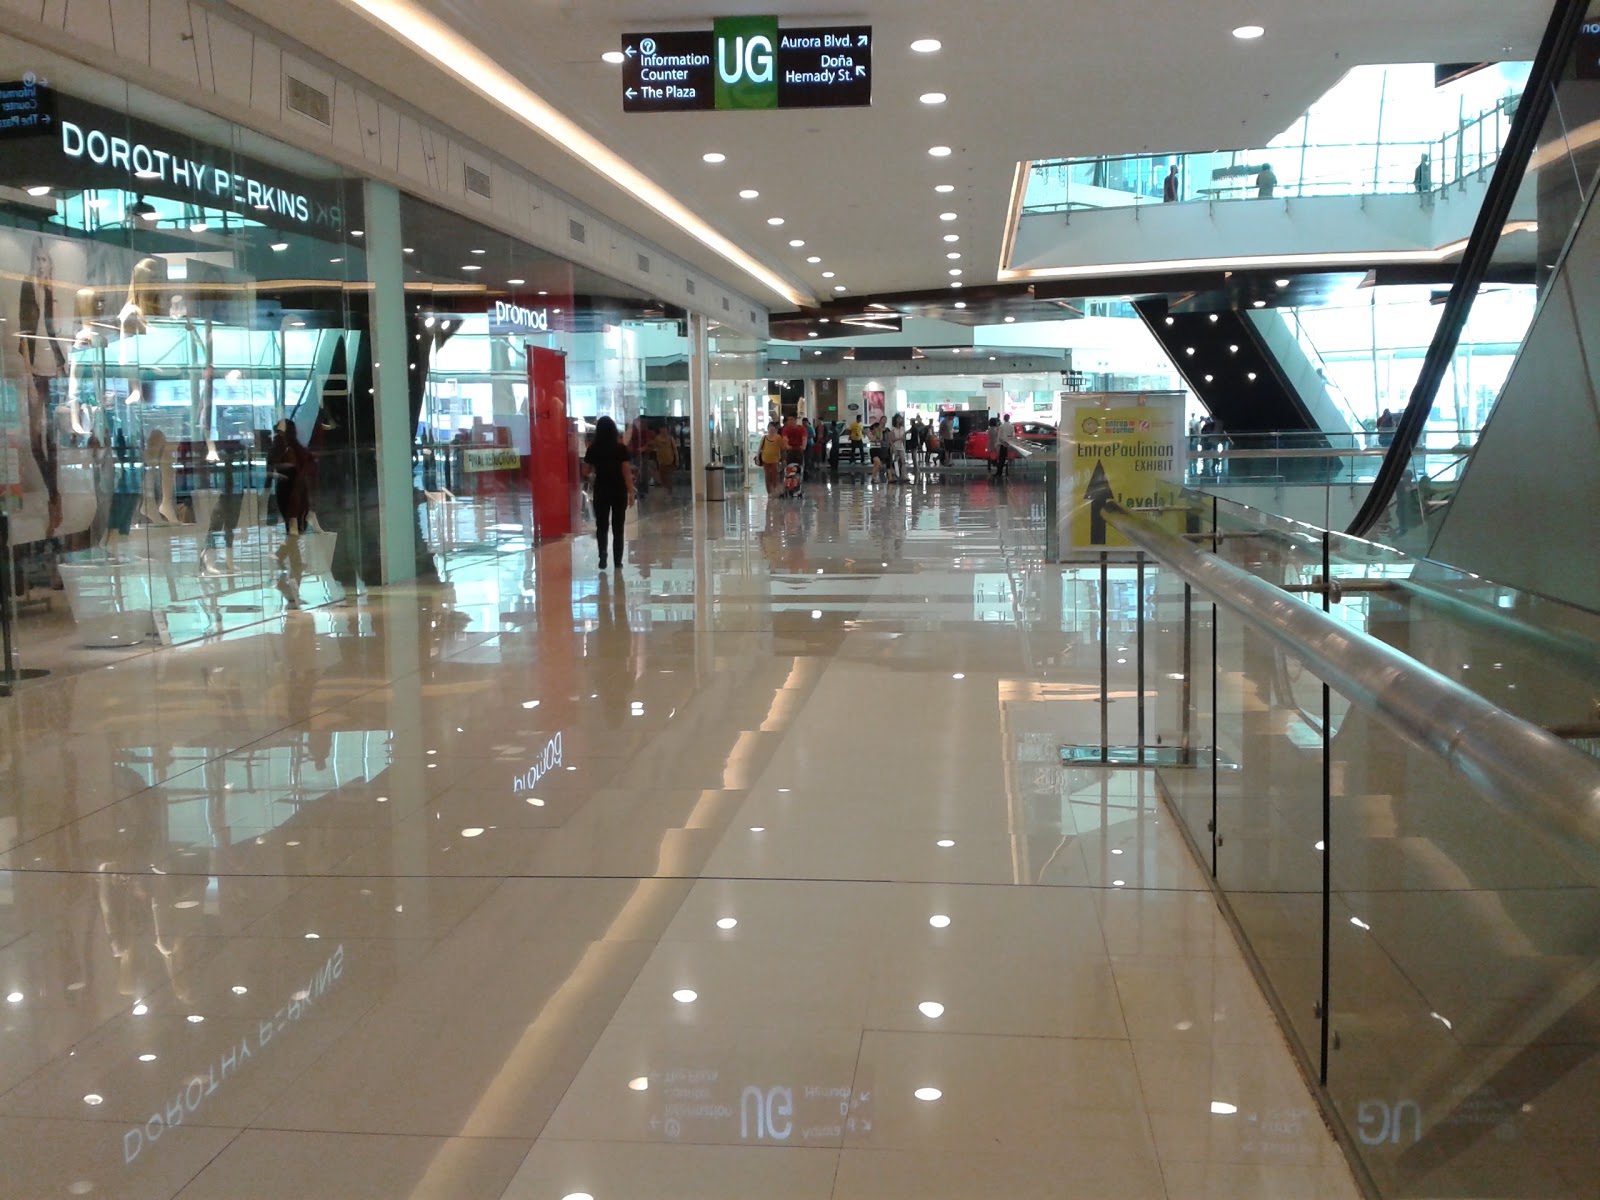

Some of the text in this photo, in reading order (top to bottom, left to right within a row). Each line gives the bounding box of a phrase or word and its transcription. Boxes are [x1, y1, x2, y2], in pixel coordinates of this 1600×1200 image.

[780, 34, 853, 48] Aurora Blvd.
[640, 53, 710, 66] Information
[718, 35, 774, 84] UG
[821, 54, 853, 67] Doña
[640, 68, 689, 81] Counter
[838, 69, 853, 82] St.
[640, 85, 697, 99] The Plaza
[61, 120, 206, 191] DOROTHY
[213, 168, 309, 222] PERKINS
[495, 300, 548, 331] promod
[1077, 440, 1174, 458] EntrePaulinian
[1134, 459, 1173, 472] EXHIBIT
